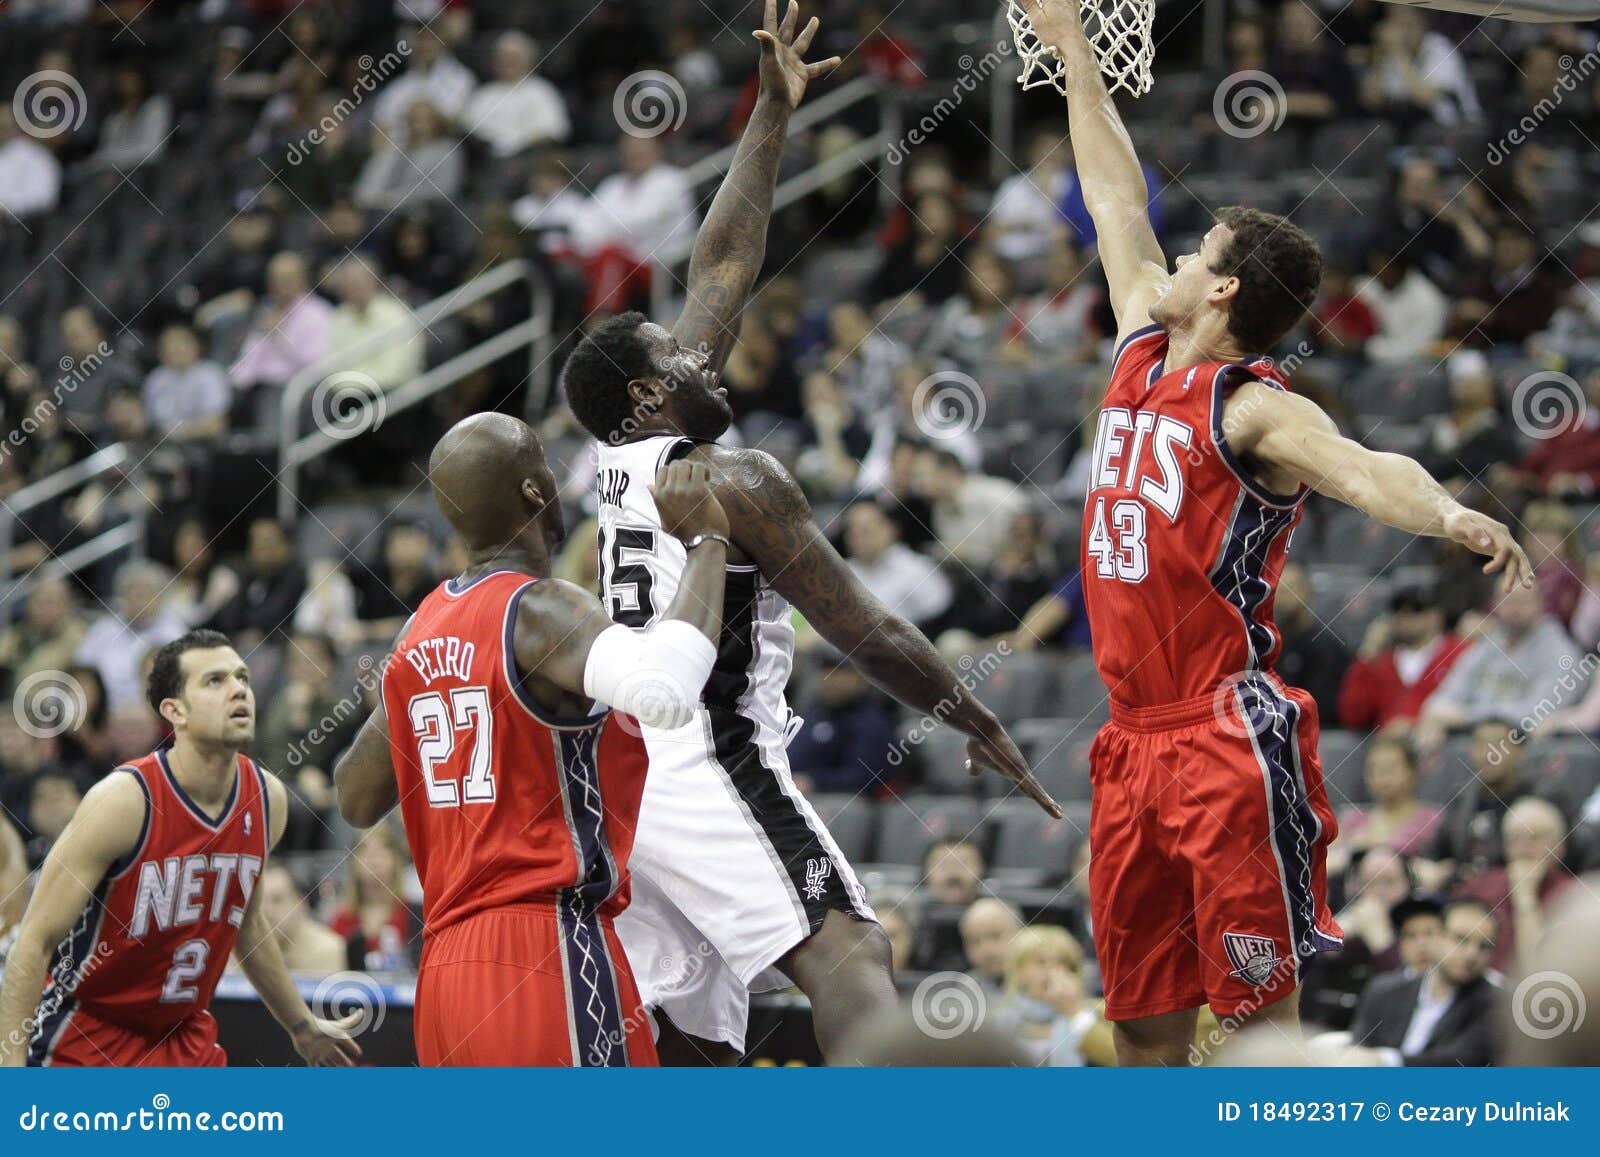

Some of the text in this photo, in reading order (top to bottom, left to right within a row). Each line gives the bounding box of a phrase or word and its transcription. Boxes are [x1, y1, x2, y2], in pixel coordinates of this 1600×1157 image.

[597, 468, 630, 509] LAIR
[1088, 496, 1149, 584] 43
[405, 636, 475, 687] PETRO
[407, 685, 496, 809] 27
[128, 852, 262, 939] NETS
[159, 938, 210, 1004] 2
[1231, 937, 1273, 967] NETS
